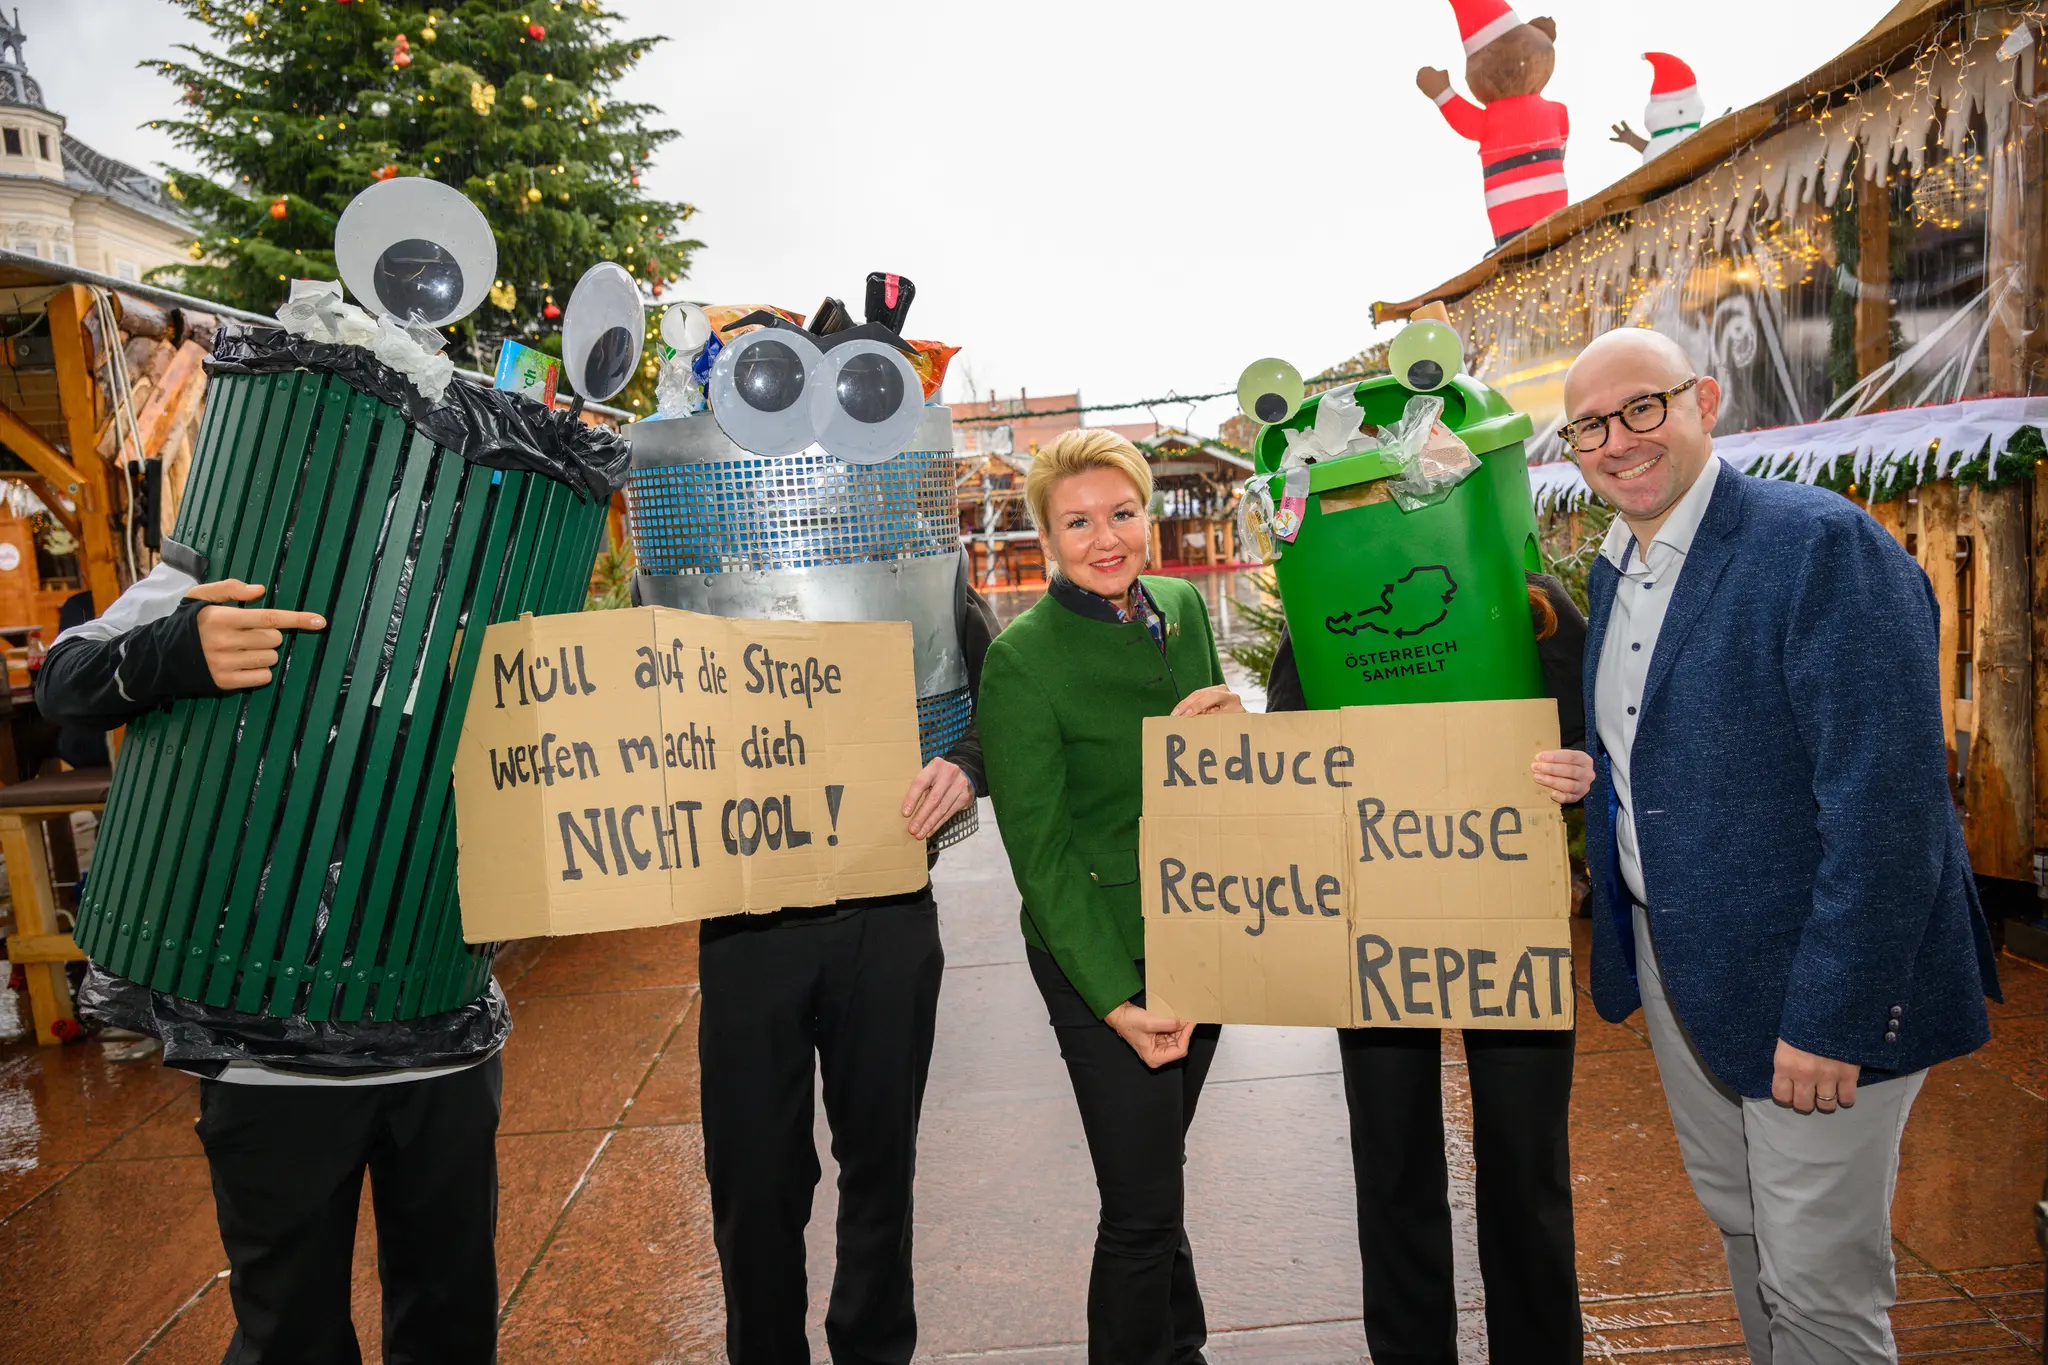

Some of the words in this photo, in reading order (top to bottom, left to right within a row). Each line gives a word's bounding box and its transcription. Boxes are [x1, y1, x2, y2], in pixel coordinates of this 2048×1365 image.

[494, 645, 596, 709] Müll
[635, 638, 684, 693] auf
[699, 646, 728, 694] die
[743, 643, 842, 708] Straße
[1345, 640, 1458, 669] ÖSTERREICH
[1362, 659, 1446, 682] SAMMELT
[489, 733, 599, 791] werfen
[618, 722, 716, 773] macht
[741, 720, 806, 770] dich
[1162, 734, 1355, 787] Reduce
[557, 800, 702, 881] NICHT
[1357, 797, 1528, 863] Reuse
[1160, 857, 1341, 936] Recycle
[1356, 934, 1571, 1022] REPEAT
